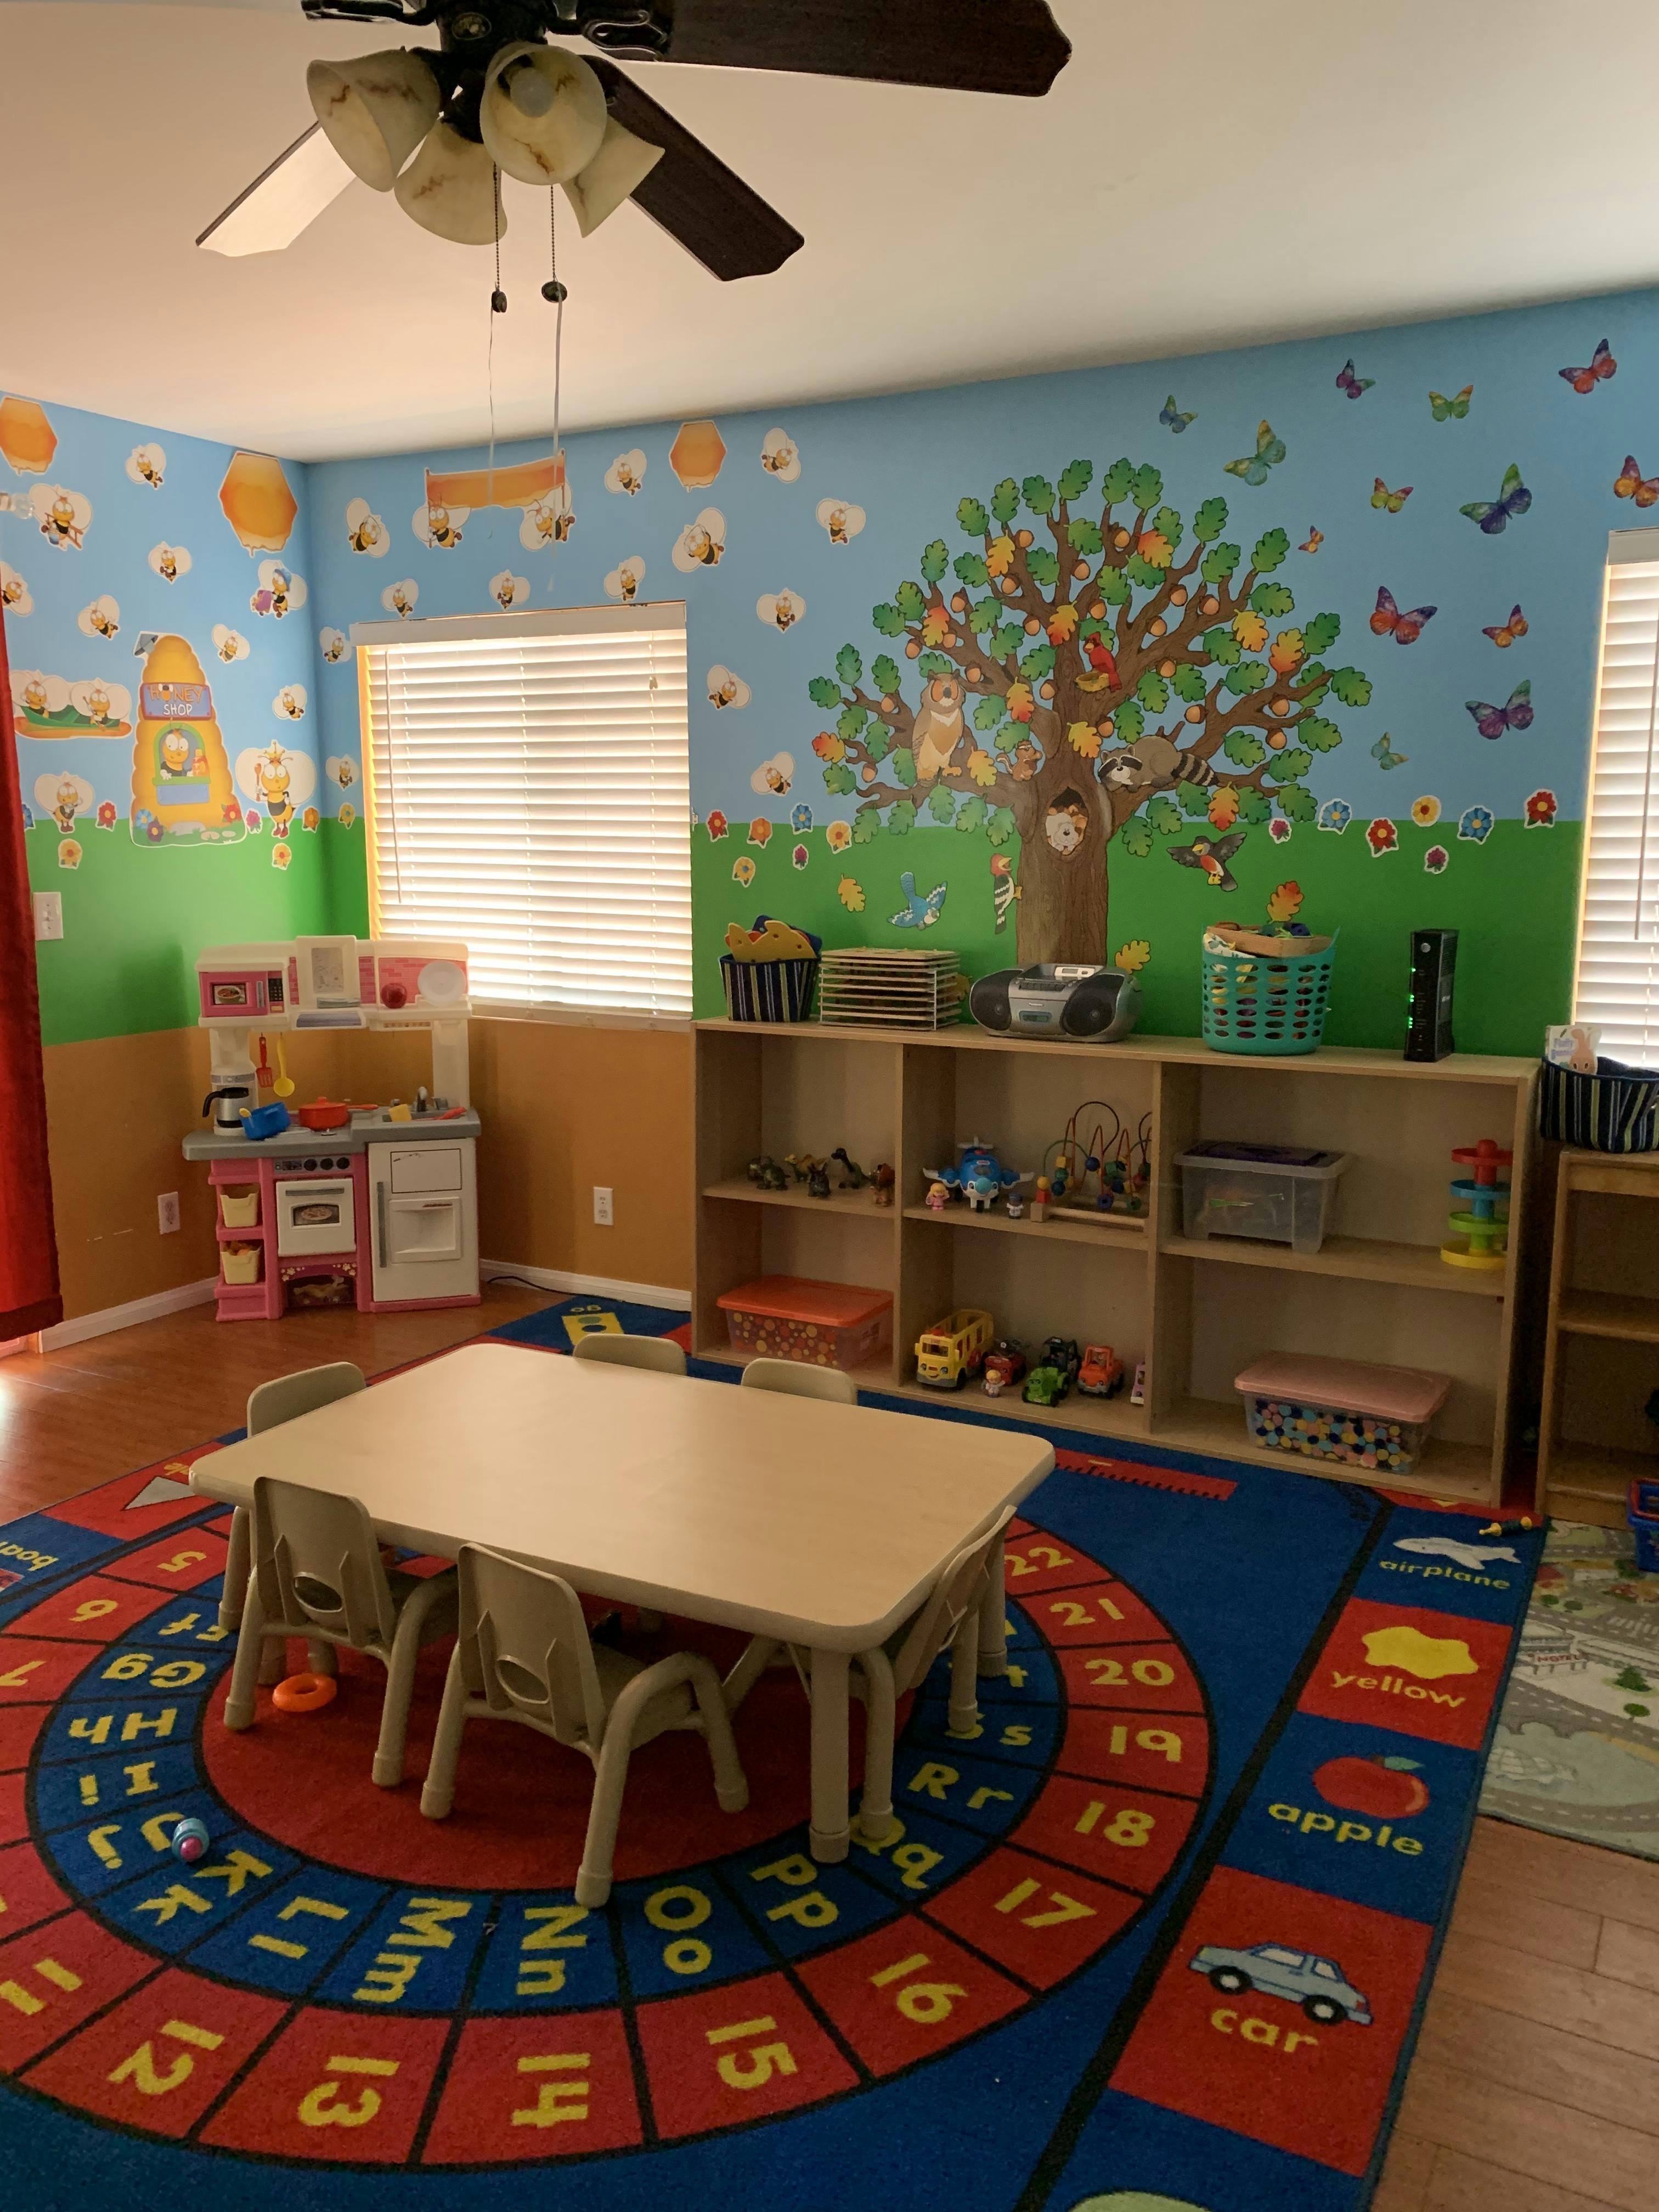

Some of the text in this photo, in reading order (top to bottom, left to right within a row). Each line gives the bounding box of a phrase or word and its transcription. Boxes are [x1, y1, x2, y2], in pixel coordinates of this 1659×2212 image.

[163, 703, 193, 716] SHOP
[0, 1542, 59, 1572] boa
[157, 1550, 207, 1573] 5
[1004, 1546, 1074, 1576] 22
[1379, 1559, 1511, 1590] airplane
[1049, 1597, 1125, 1627] 21
[1085, 1658, 1176, 1686] 20
[1330, 1671, 1467, 1708] yellow
[1109, 1725, 1183, 1762] 19
[1074, 1800, 1155, 1847] 18
[1268, 1802, 1424, 1855] apple
[994, 1877, 1098, 1929] 17
[0, 1958, 83, 2015] 11
[870, 1953, 969, 2024] 16
[706, 2015, 798, 2090] 15
[1211, 2008, 1319, 2053] car
[108, 2020, 225, 2096] 12
[297, 2055, 400, 2127] 13
[511, 2053, 591, 2129] 14
